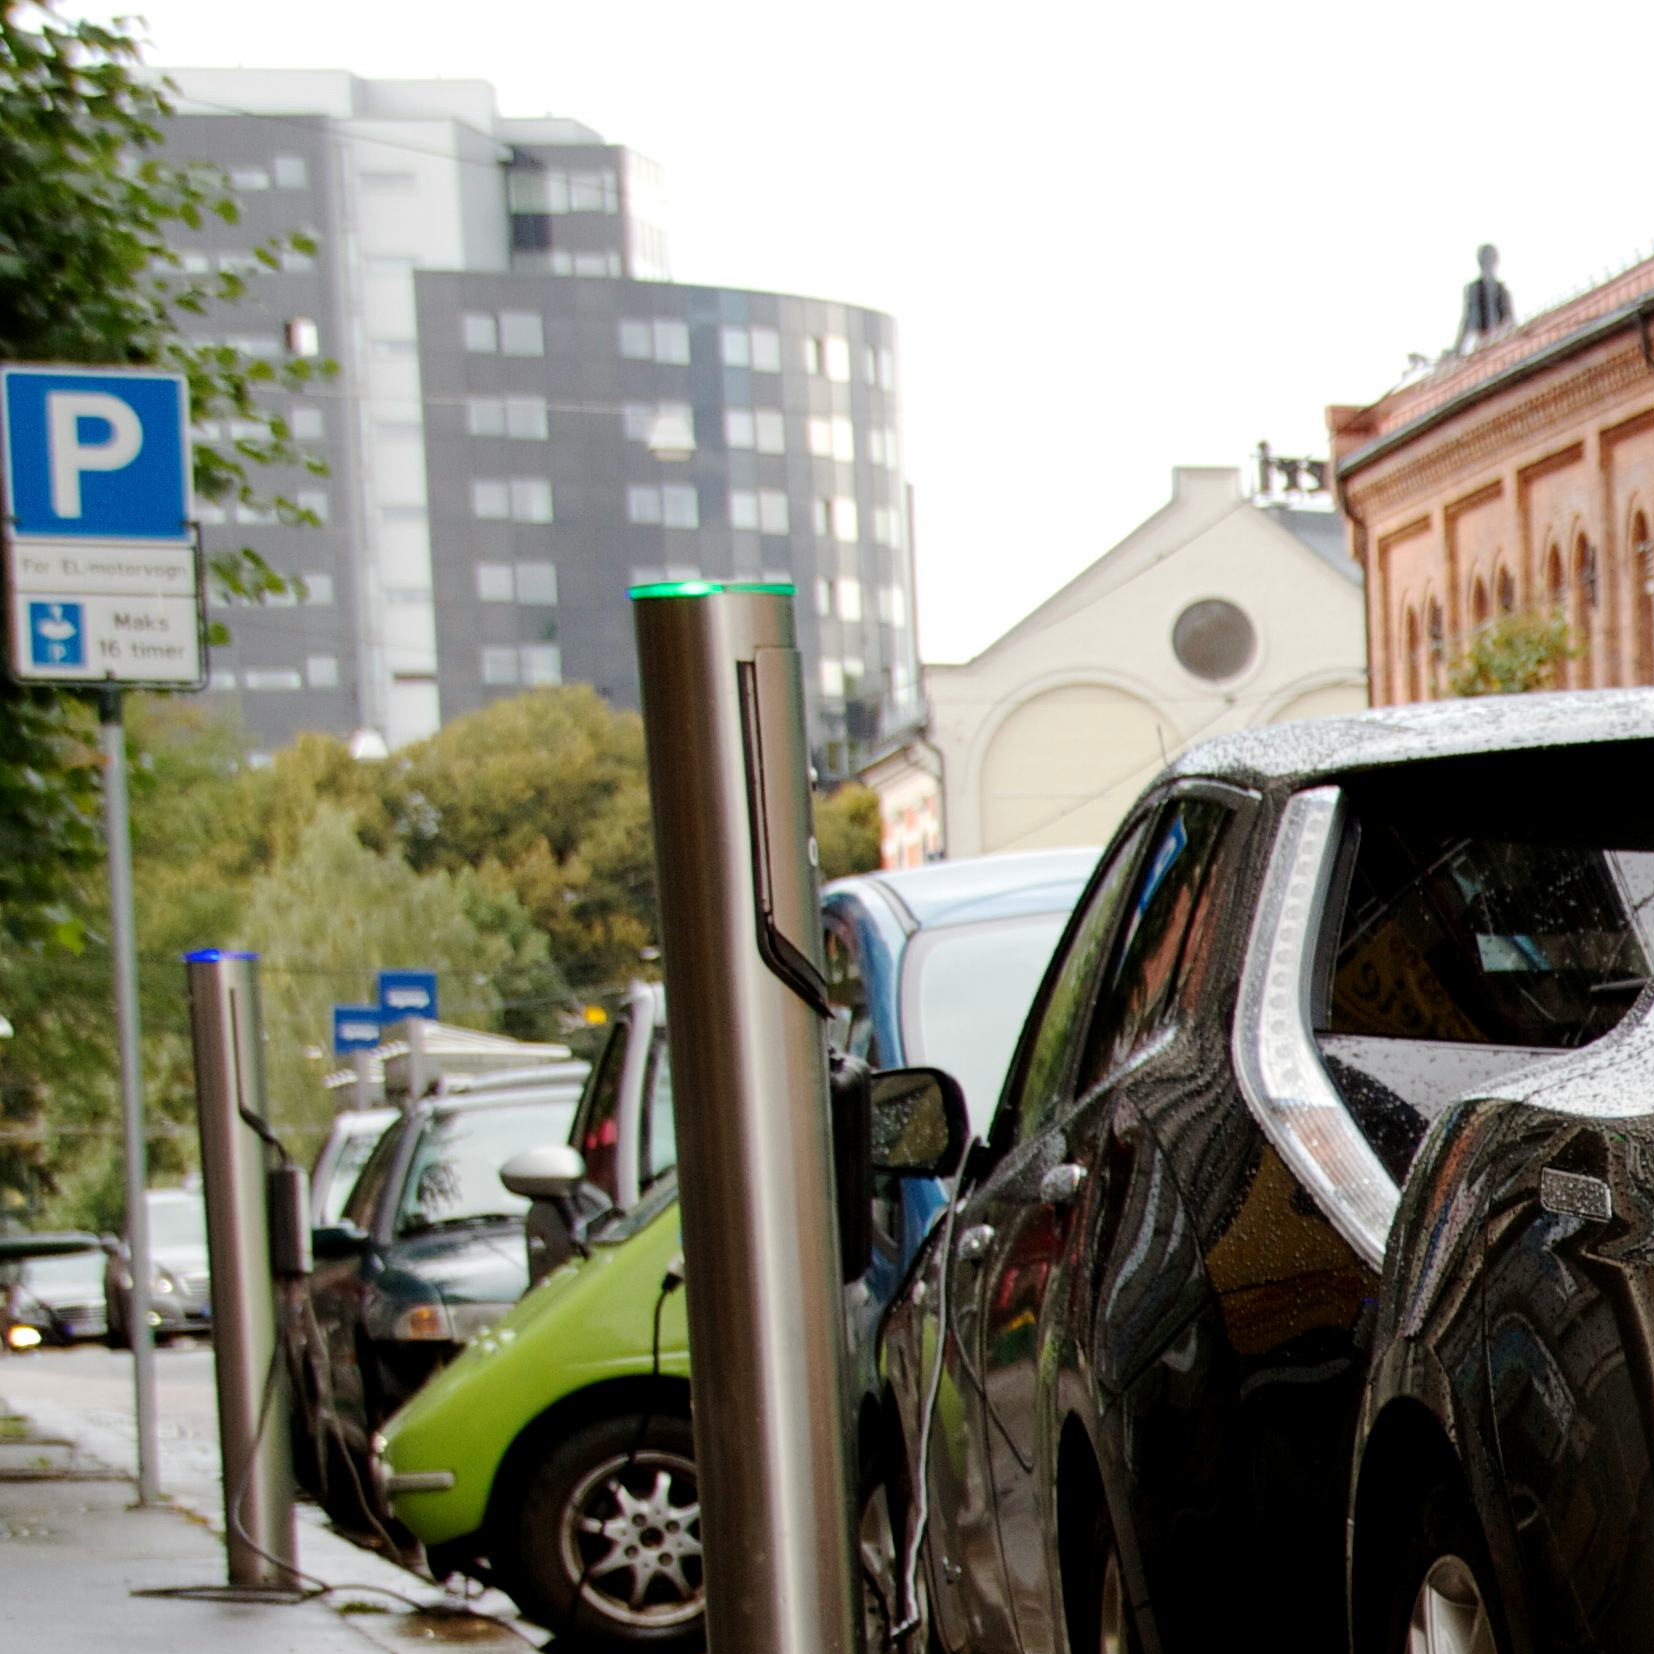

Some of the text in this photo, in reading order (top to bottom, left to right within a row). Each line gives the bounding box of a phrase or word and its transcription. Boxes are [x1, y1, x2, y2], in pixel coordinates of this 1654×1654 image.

[46, 390, 144, 519] P
[114, 612, 169, 631] Maks
[131, 641, 184, 659] timer
